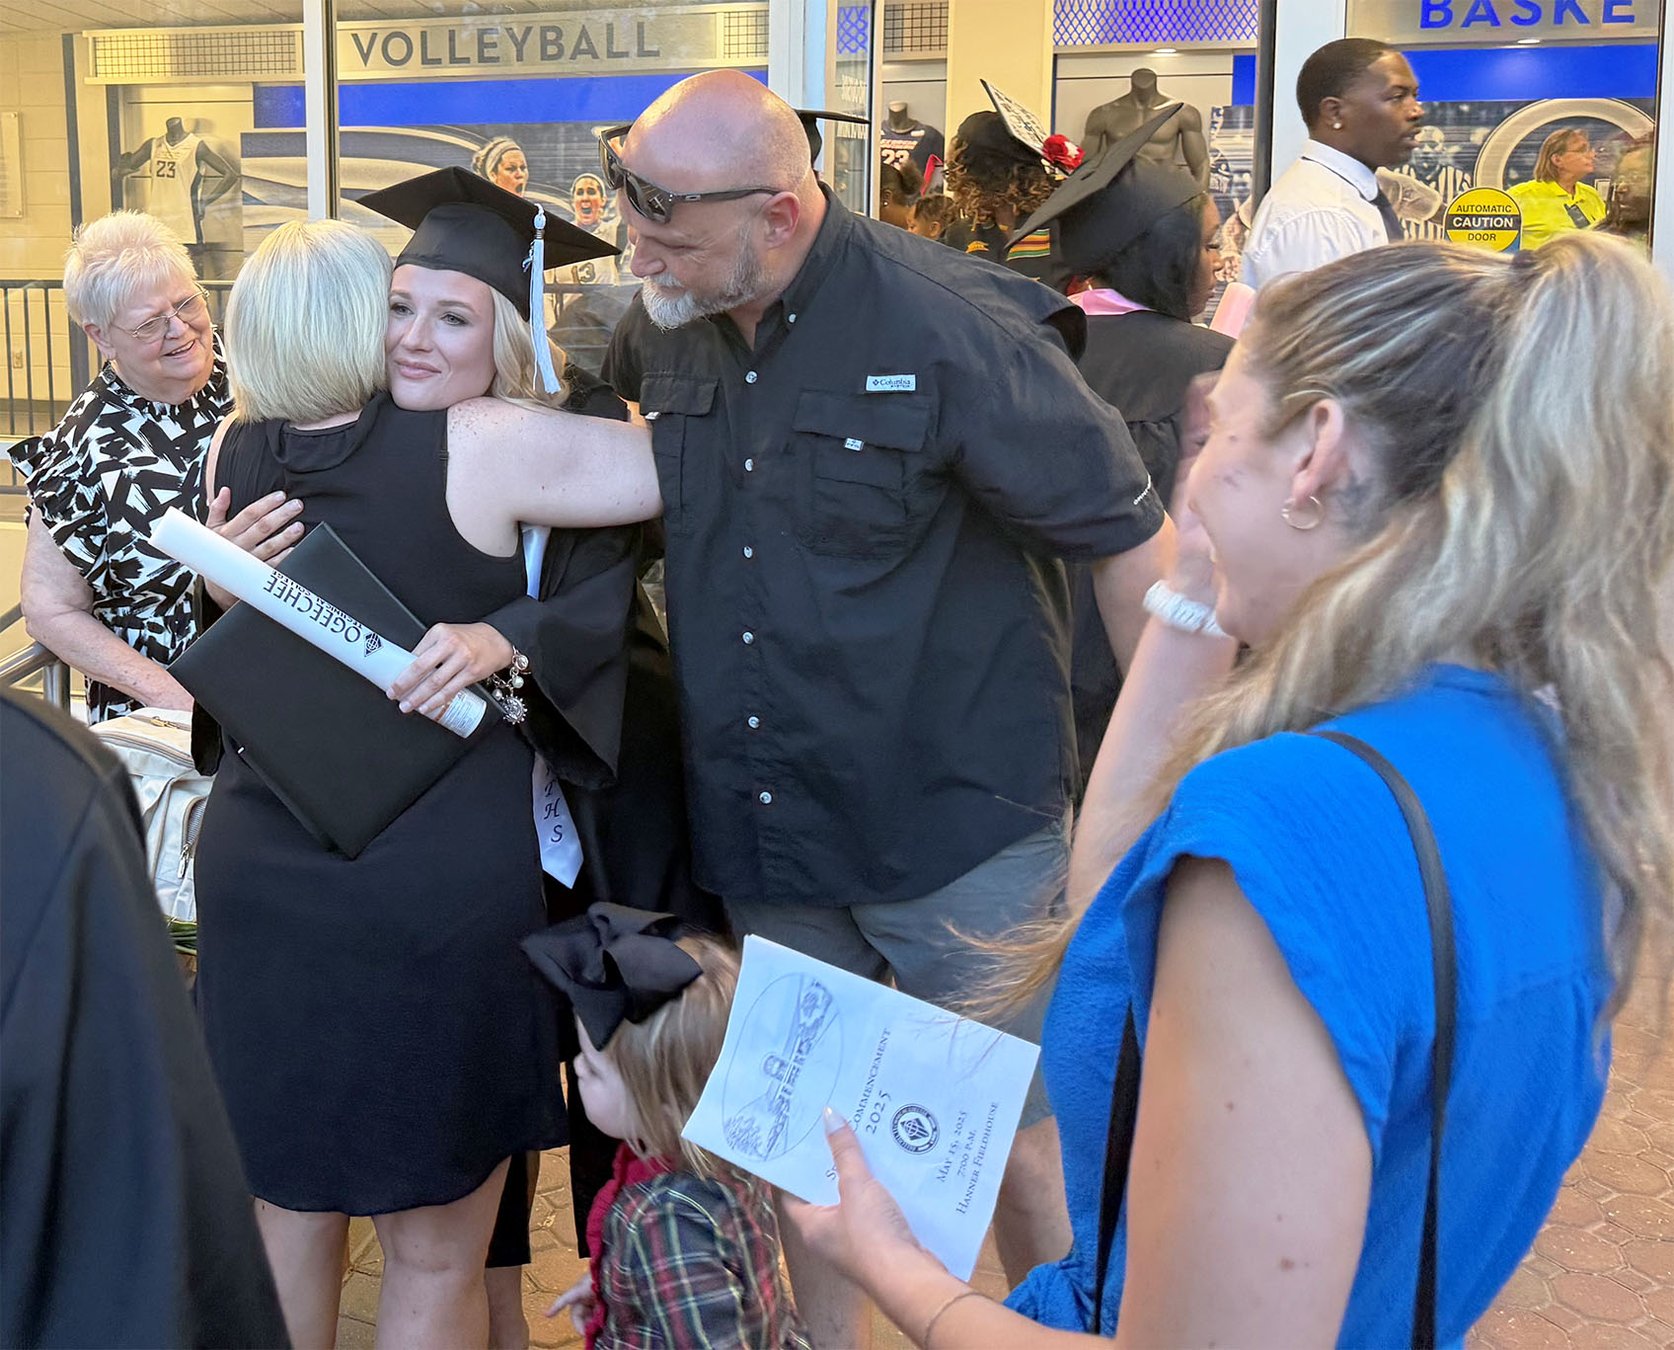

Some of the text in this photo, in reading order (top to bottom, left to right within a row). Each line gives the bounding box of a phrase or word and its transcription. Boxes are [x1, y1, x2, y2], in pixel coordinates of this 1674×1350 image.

[1419, 0, 1636, 28] BASKE
[351, 21, 661, 67] VOLLEYBALL
[156, 160, 176, 178] 23
[1456, 204, 1512, 213] AUTOMATIC
[1452, 216, 1513, 228] CAUTION
[1467, 232, 1497, 241] DOOR
[263, 574, 362, 643] OGEECHEE
[865, 1089, 892, 1135] 2025
[954, 1110, 968, 1136] 2025
